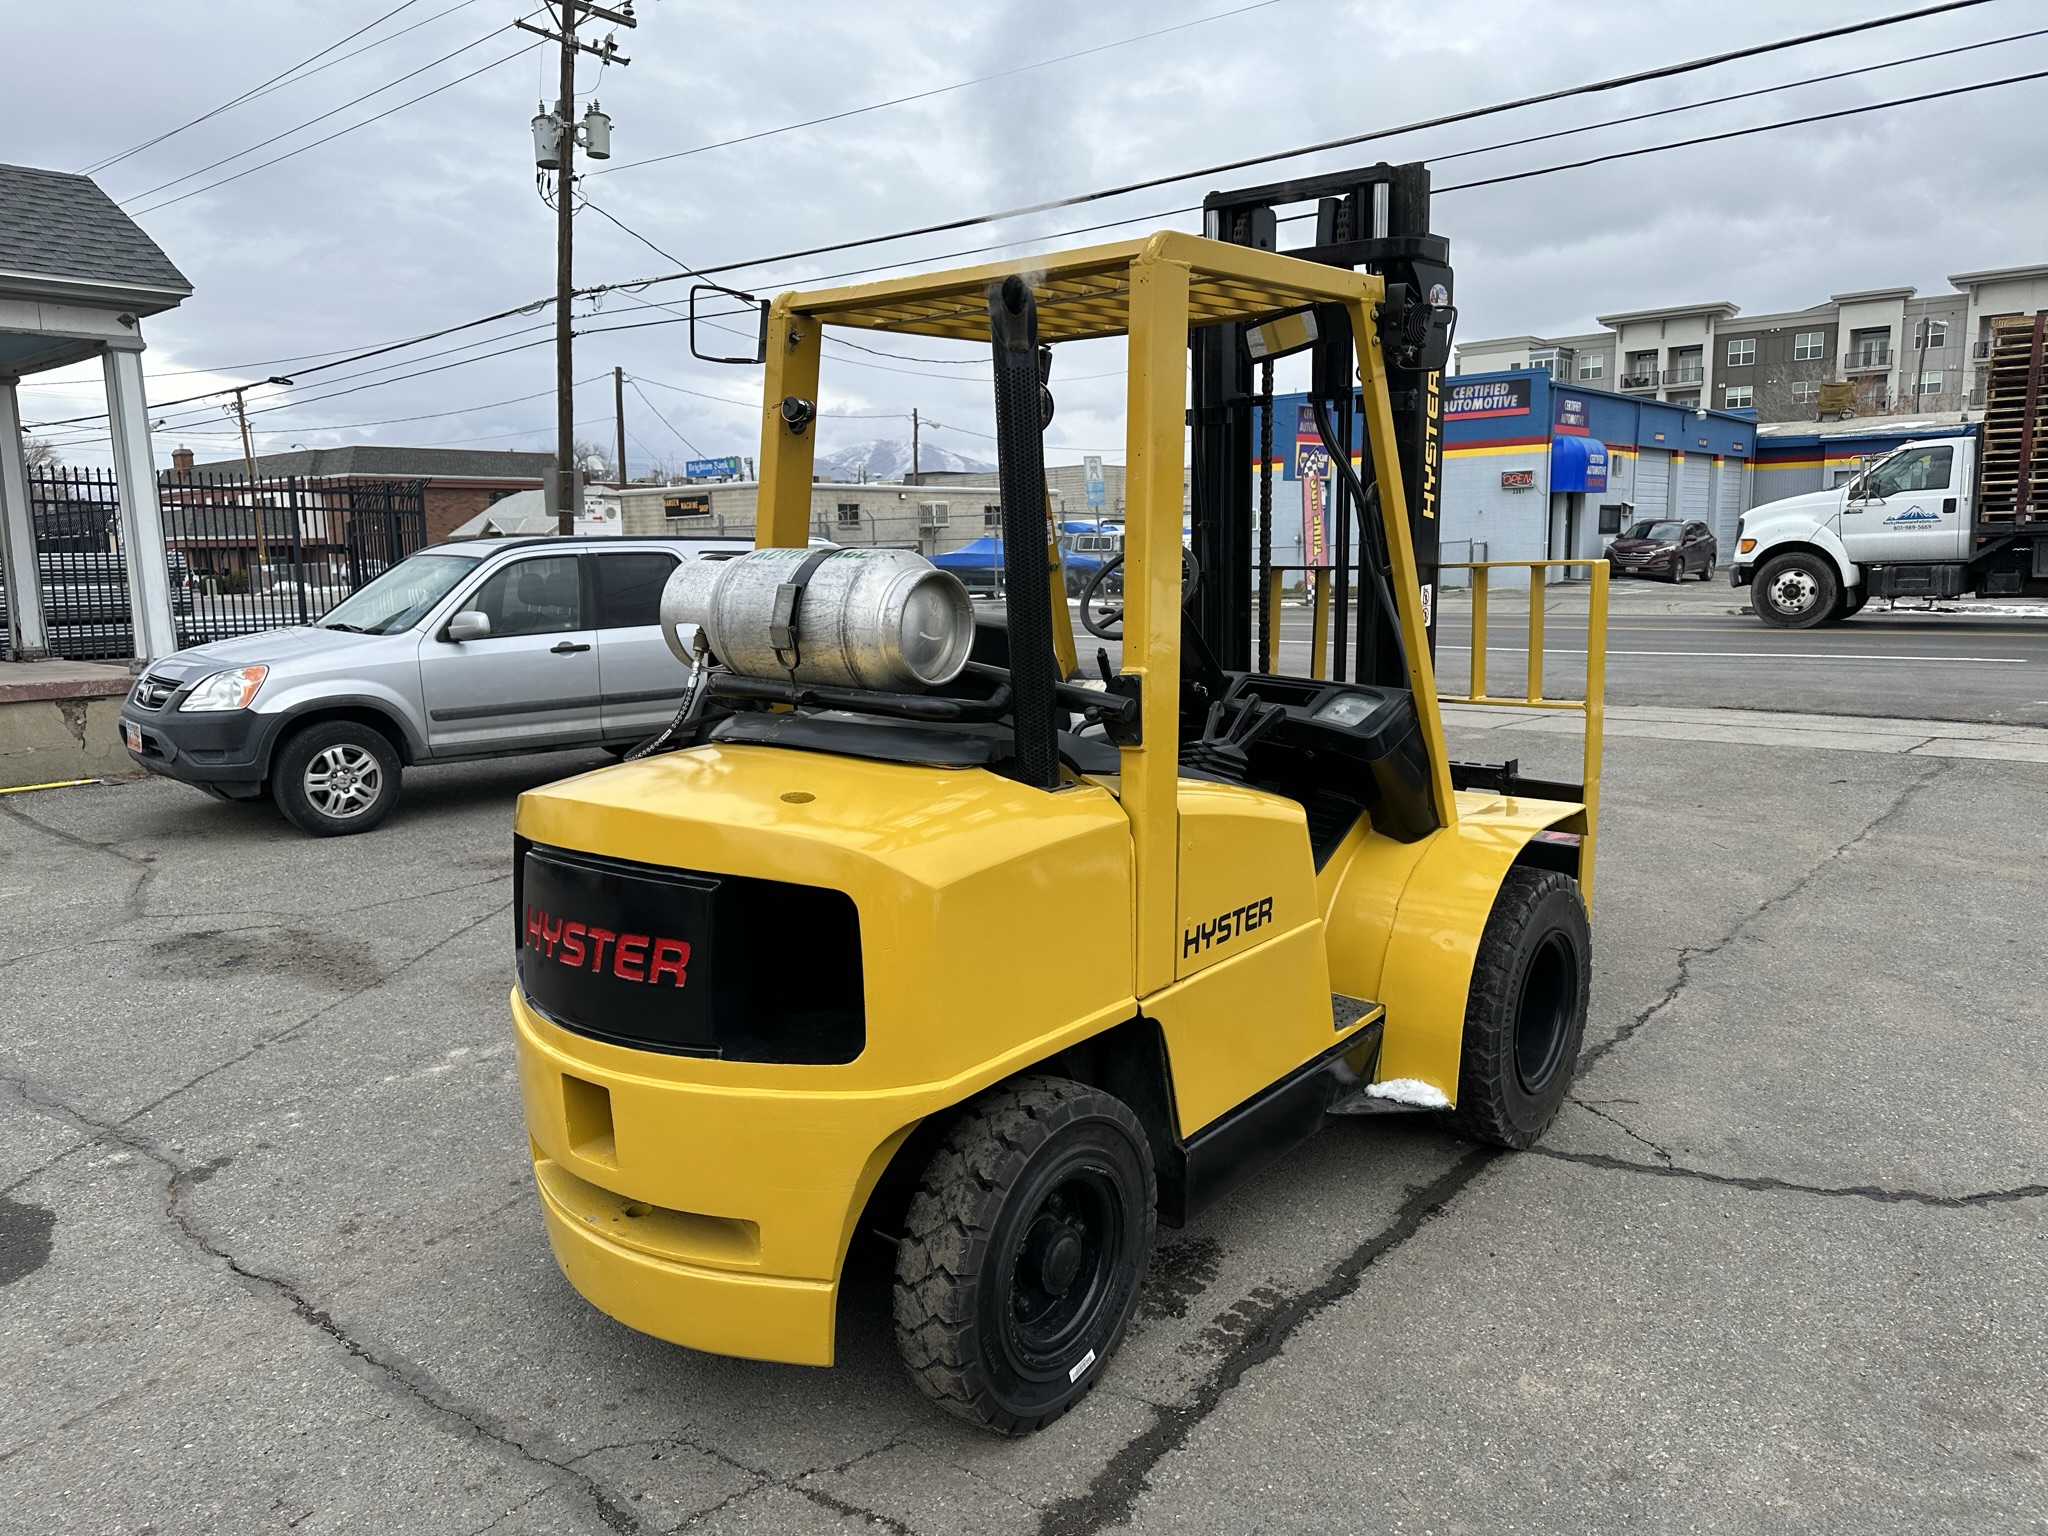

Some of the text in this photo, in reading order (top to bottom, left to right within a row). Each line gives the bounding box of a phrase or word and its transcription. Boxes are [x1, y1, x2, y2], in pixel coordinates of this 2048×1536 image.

[1443, 394, 1518, 413] AUTOMOTIVE
[1453, 383, 1509, 399] CERTIFIED
[1422, 370, 1440, 519] HYSTER
[1503, 474, 1532, 485] OPEN
[526, 904, 691, 988] HYSTER
[1183, 896, 1273, 960] HYSTER
